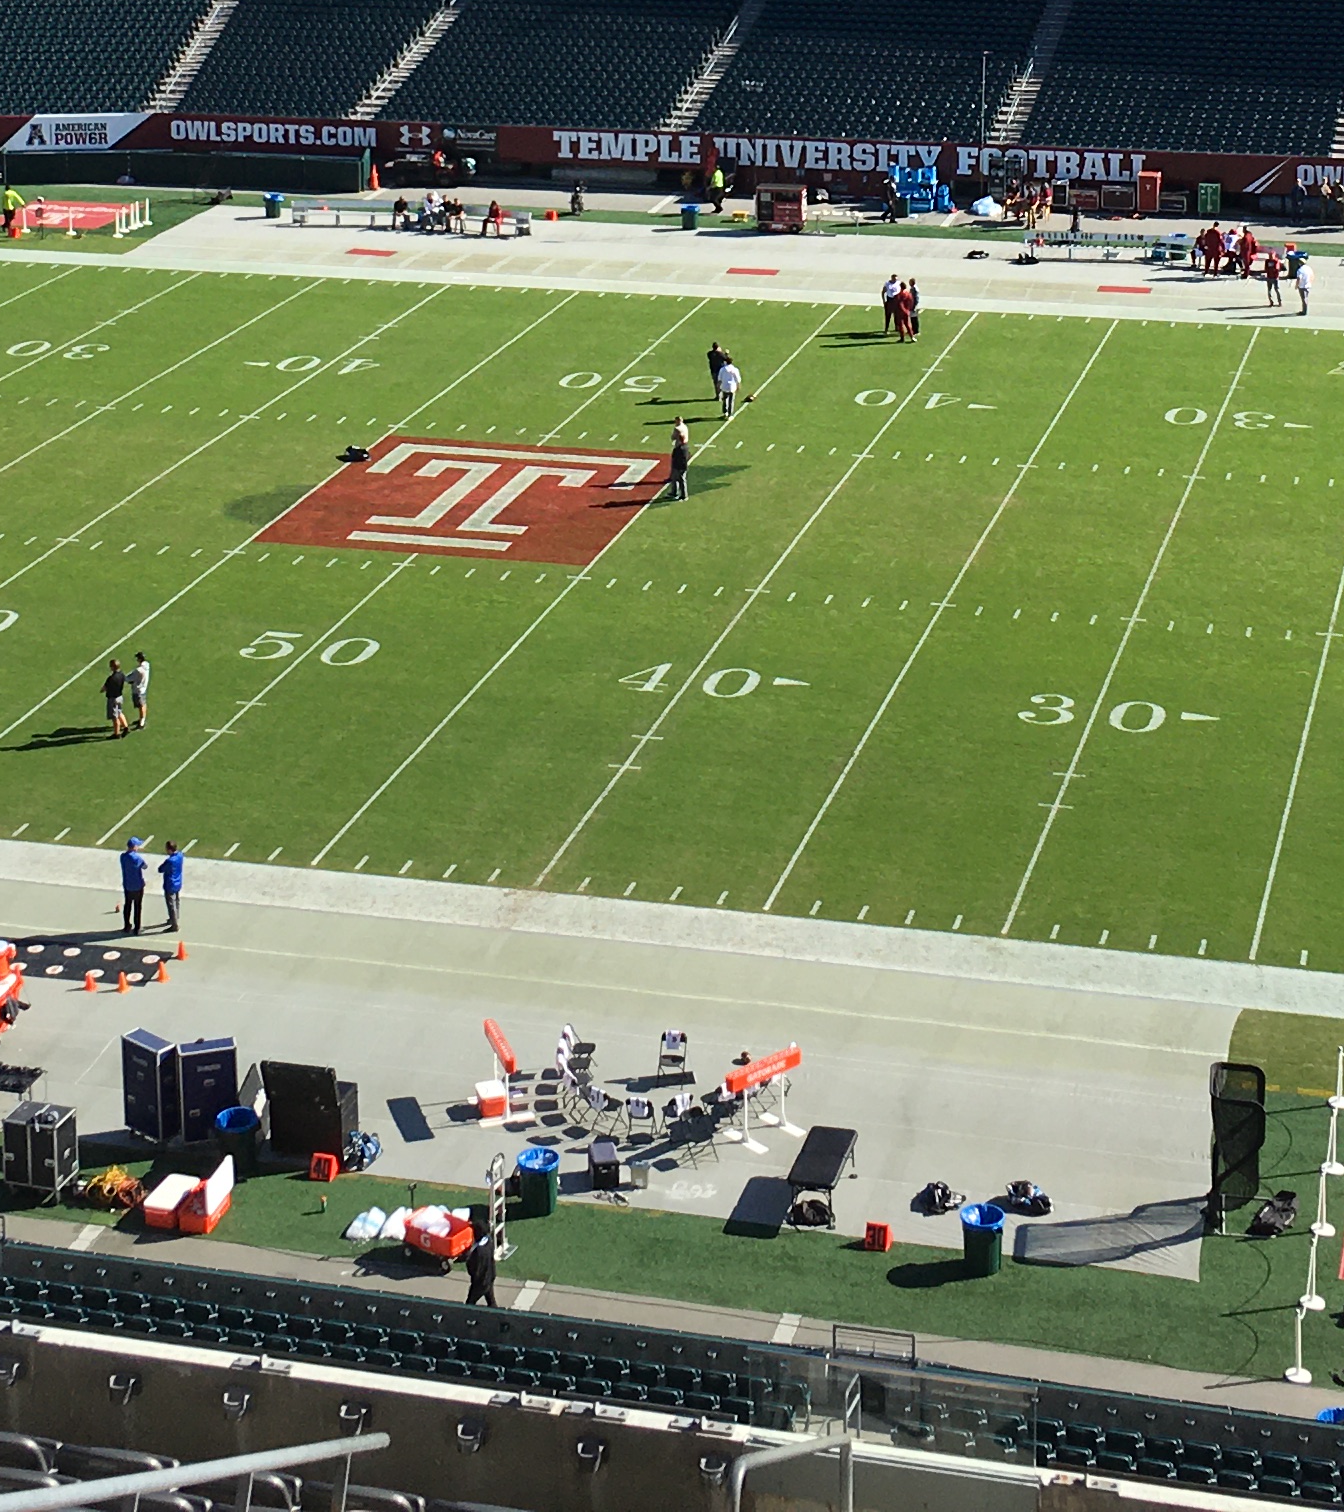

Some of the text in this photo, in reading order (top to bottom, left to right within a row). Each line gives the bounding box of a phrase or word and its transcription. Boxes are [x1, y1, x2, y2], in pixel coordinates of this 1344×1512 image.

[54, 123, 107, 132] AMERICAN
[54, 132, 108, 146] POW6R
[170, 119, 377, 147] OWLSPORTS.COM
[457, 129, 497, 140] NovaCare
[553, 130, 700, 164] TEMPLE
[713, 137, 942, 173] UNIVERSITY
[239, 629, 381, 668] 50
[618, 662, 762, 699] 40
[1016, 692, 1169, 735] 30
[420, 1234, 432, 1248] G
